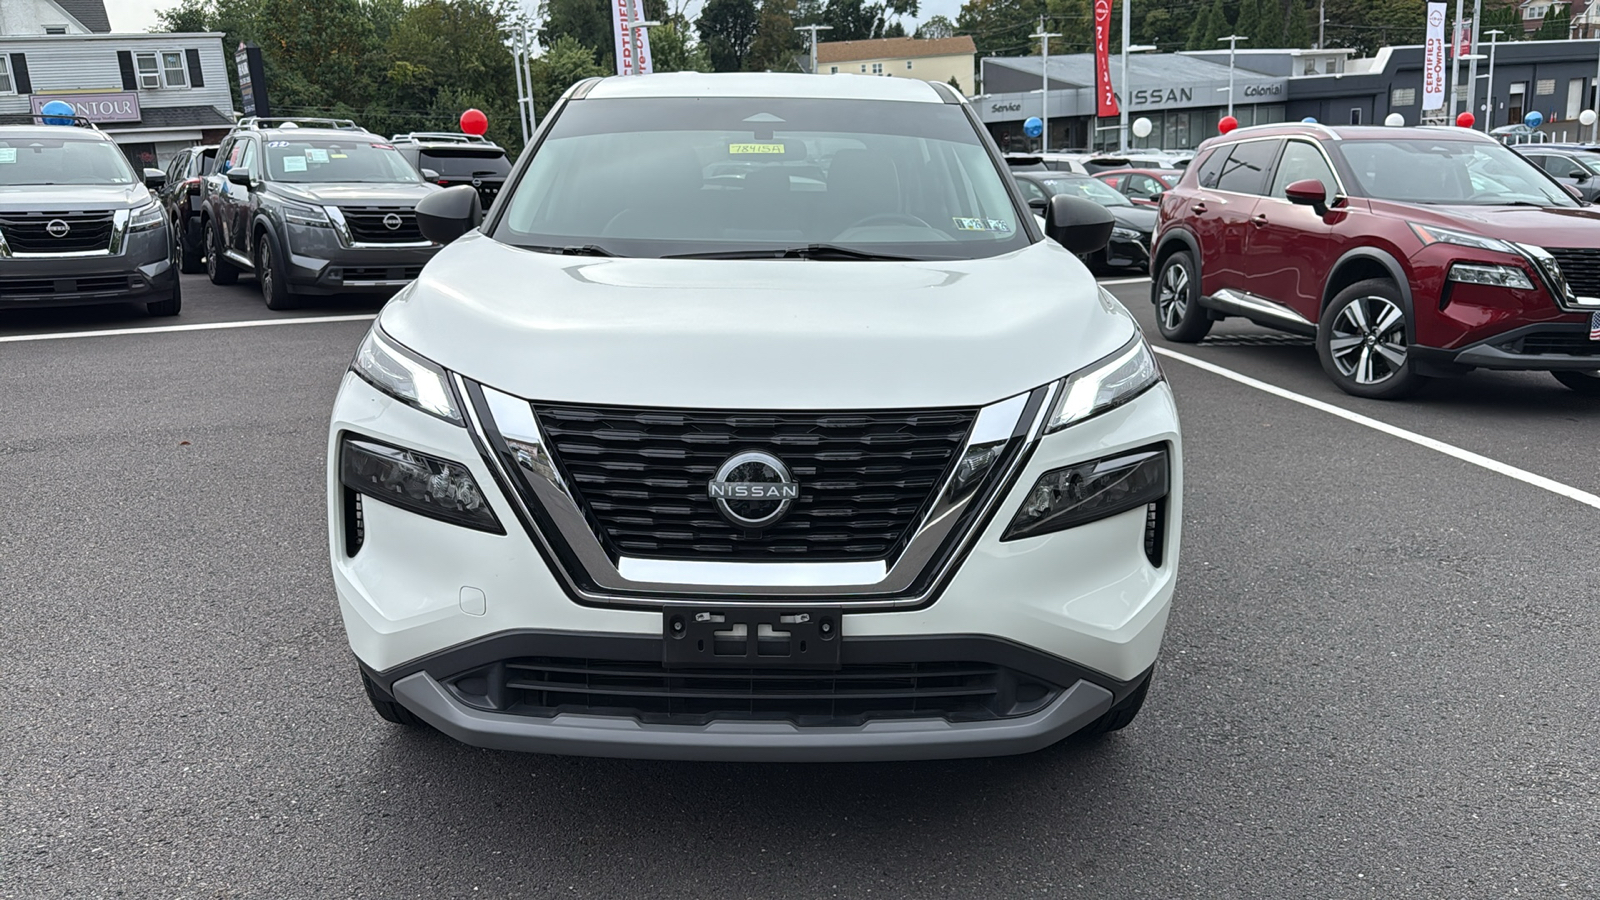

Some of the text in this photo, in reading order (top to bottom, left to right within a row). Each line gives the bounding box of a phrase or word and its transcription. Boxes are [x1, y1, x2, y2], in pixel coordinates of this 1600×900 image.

[1426, 38, 1434, 93] CERTIFIED
[1434, 39, 1442, 93] Pre-Owned
[1244, 84, 1283, 97] Colonial
[991, 102, 1021, 113] Service
[711, 485, 796, 497] NISSAN
